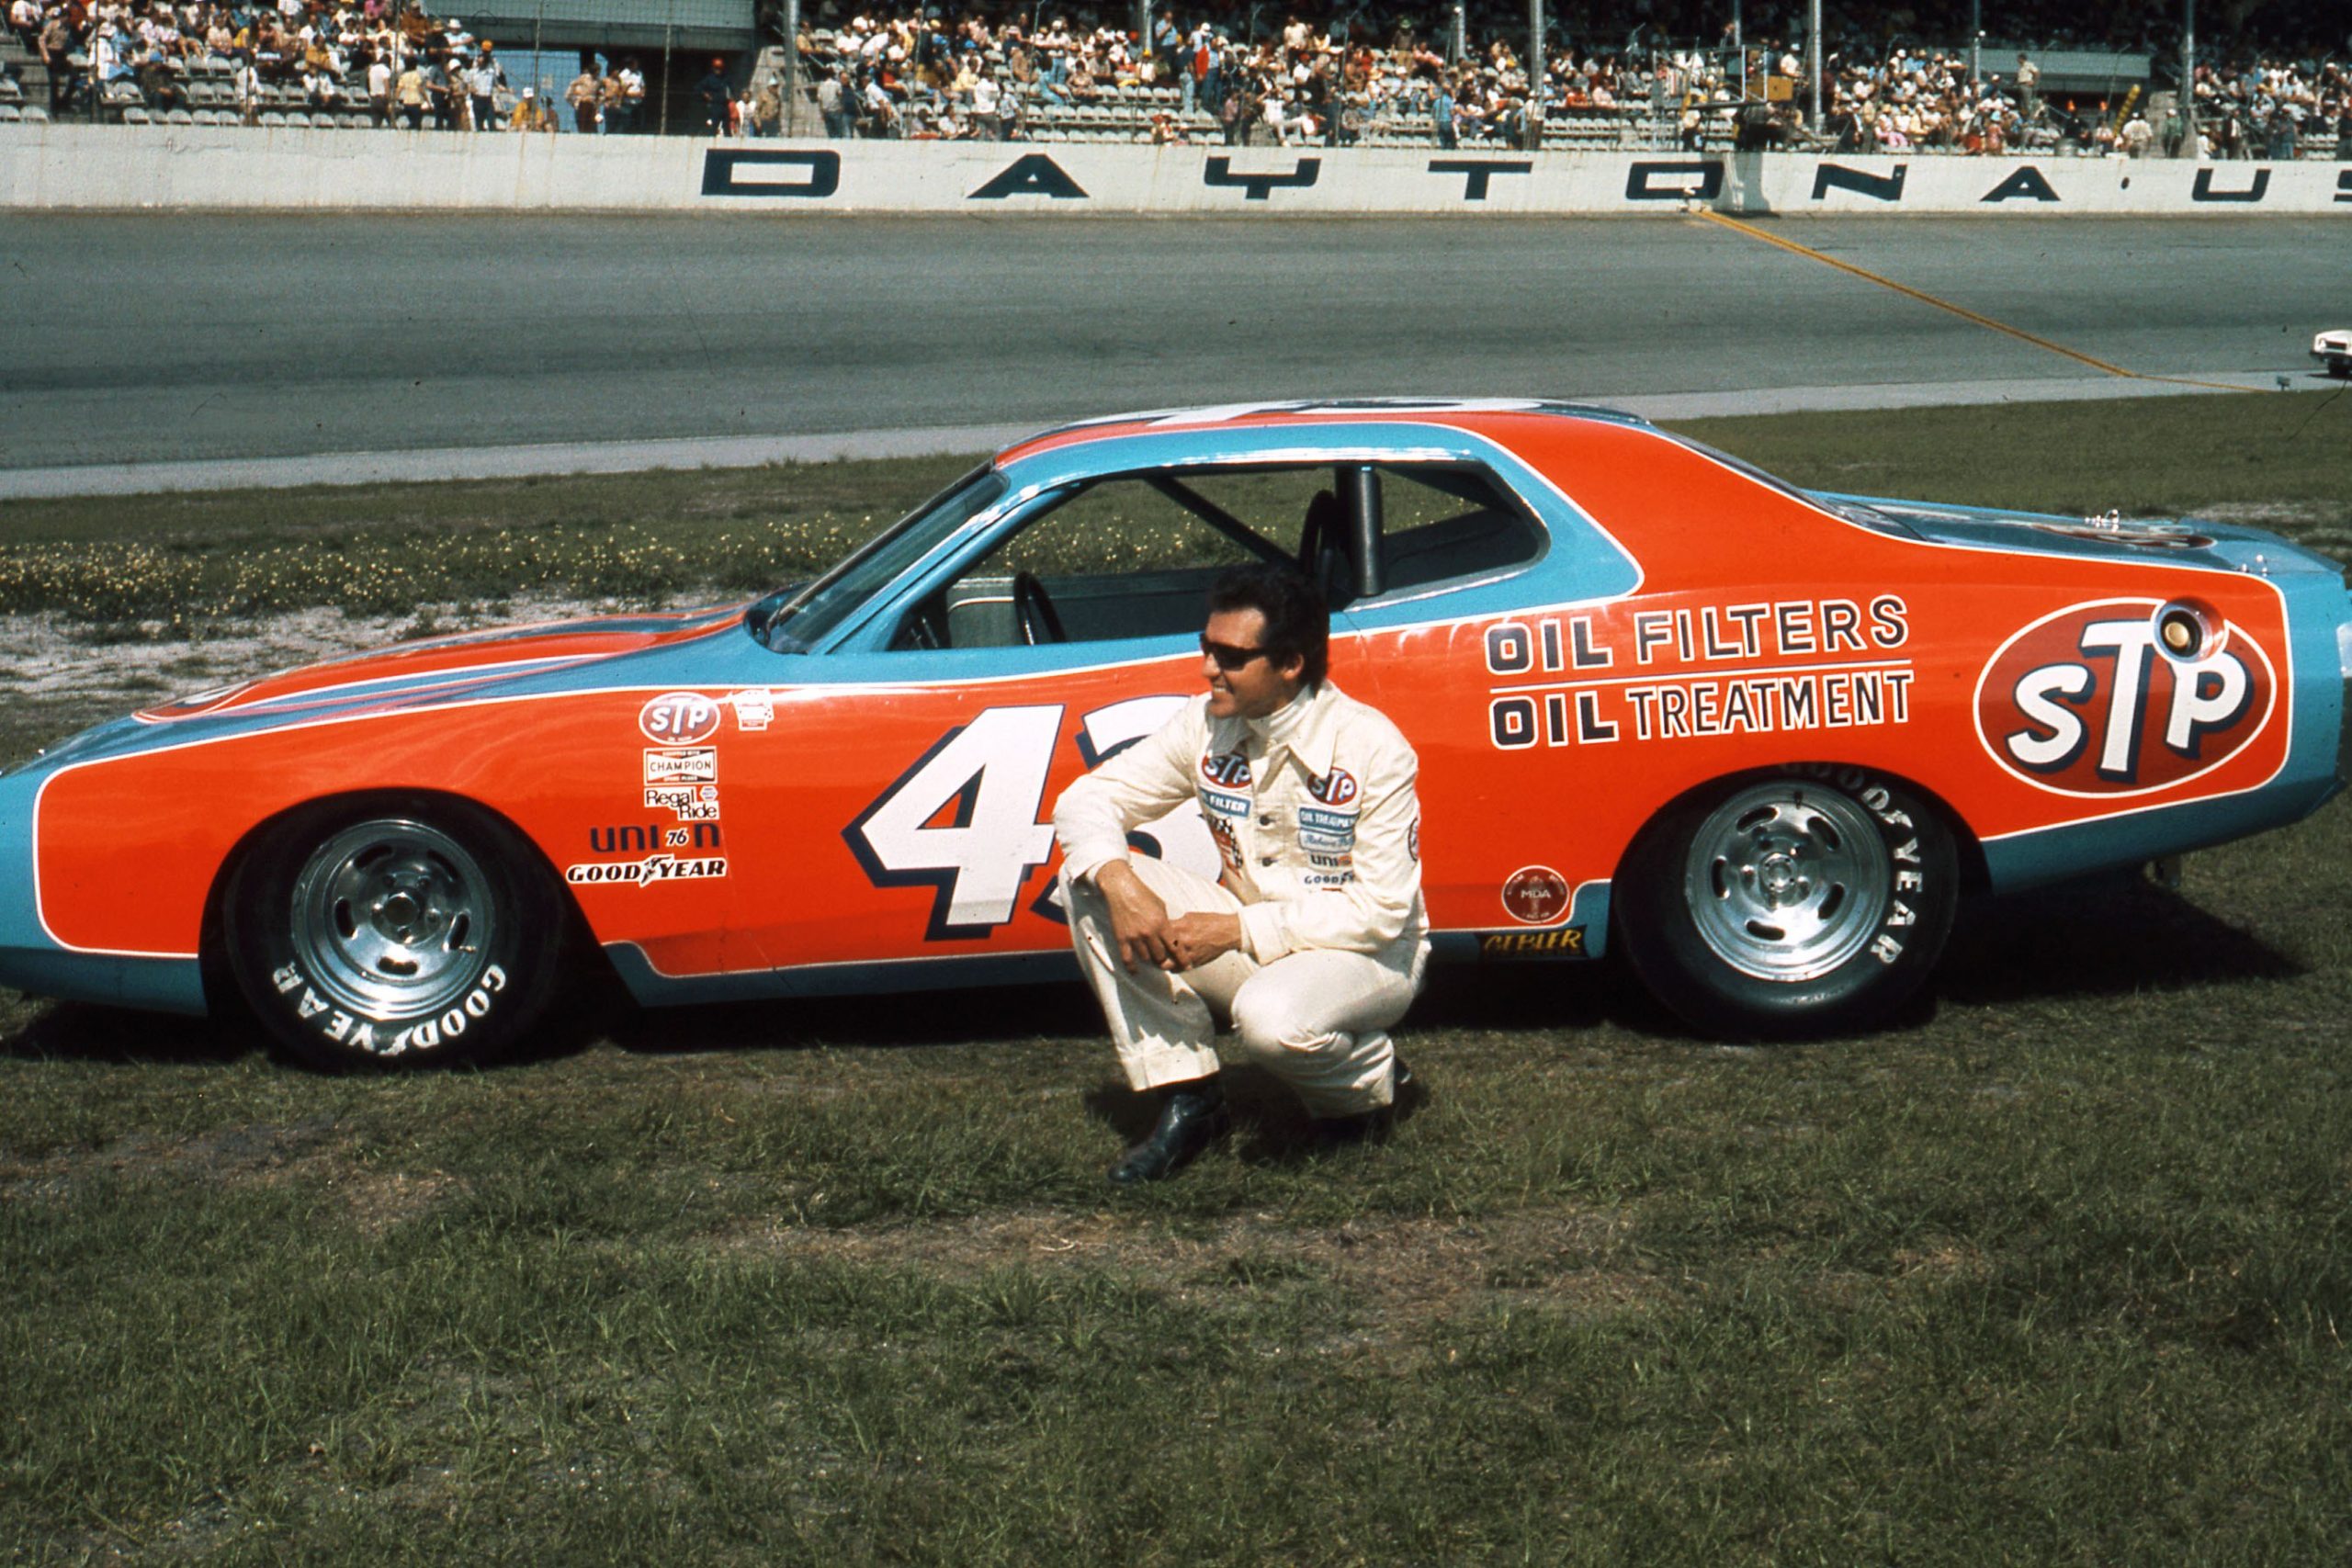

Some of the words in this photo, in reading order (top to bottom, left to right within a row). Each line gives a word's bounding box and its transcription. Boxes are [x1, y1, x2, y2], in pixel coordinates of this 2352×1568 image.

[701, 148, 2061, 202] DAYTONA
[2191, 169, 2352, 203] U
[1485, 615, 1613, 675] OIL
[1634, 595, 1908, 664] FILTERS
[650, 697, 711, 735] STP
[1489, 691, 1620, 750] OIL
[1626, 670, 1915, 740] TREATMENT
[2005, 619, 2255, 784] STP
[650, 760, 712, 773] CHAMPION
[1204, 756, 1251, 784] STP
[646, 788, 695, 808] Regal
[1311, 769, 1354, 802] STP
[679, 802, 718, 819] Ride
[567, 856, 726, 884] GOODYEAR
[272, 962, 507, 1055] GOODYEAR
